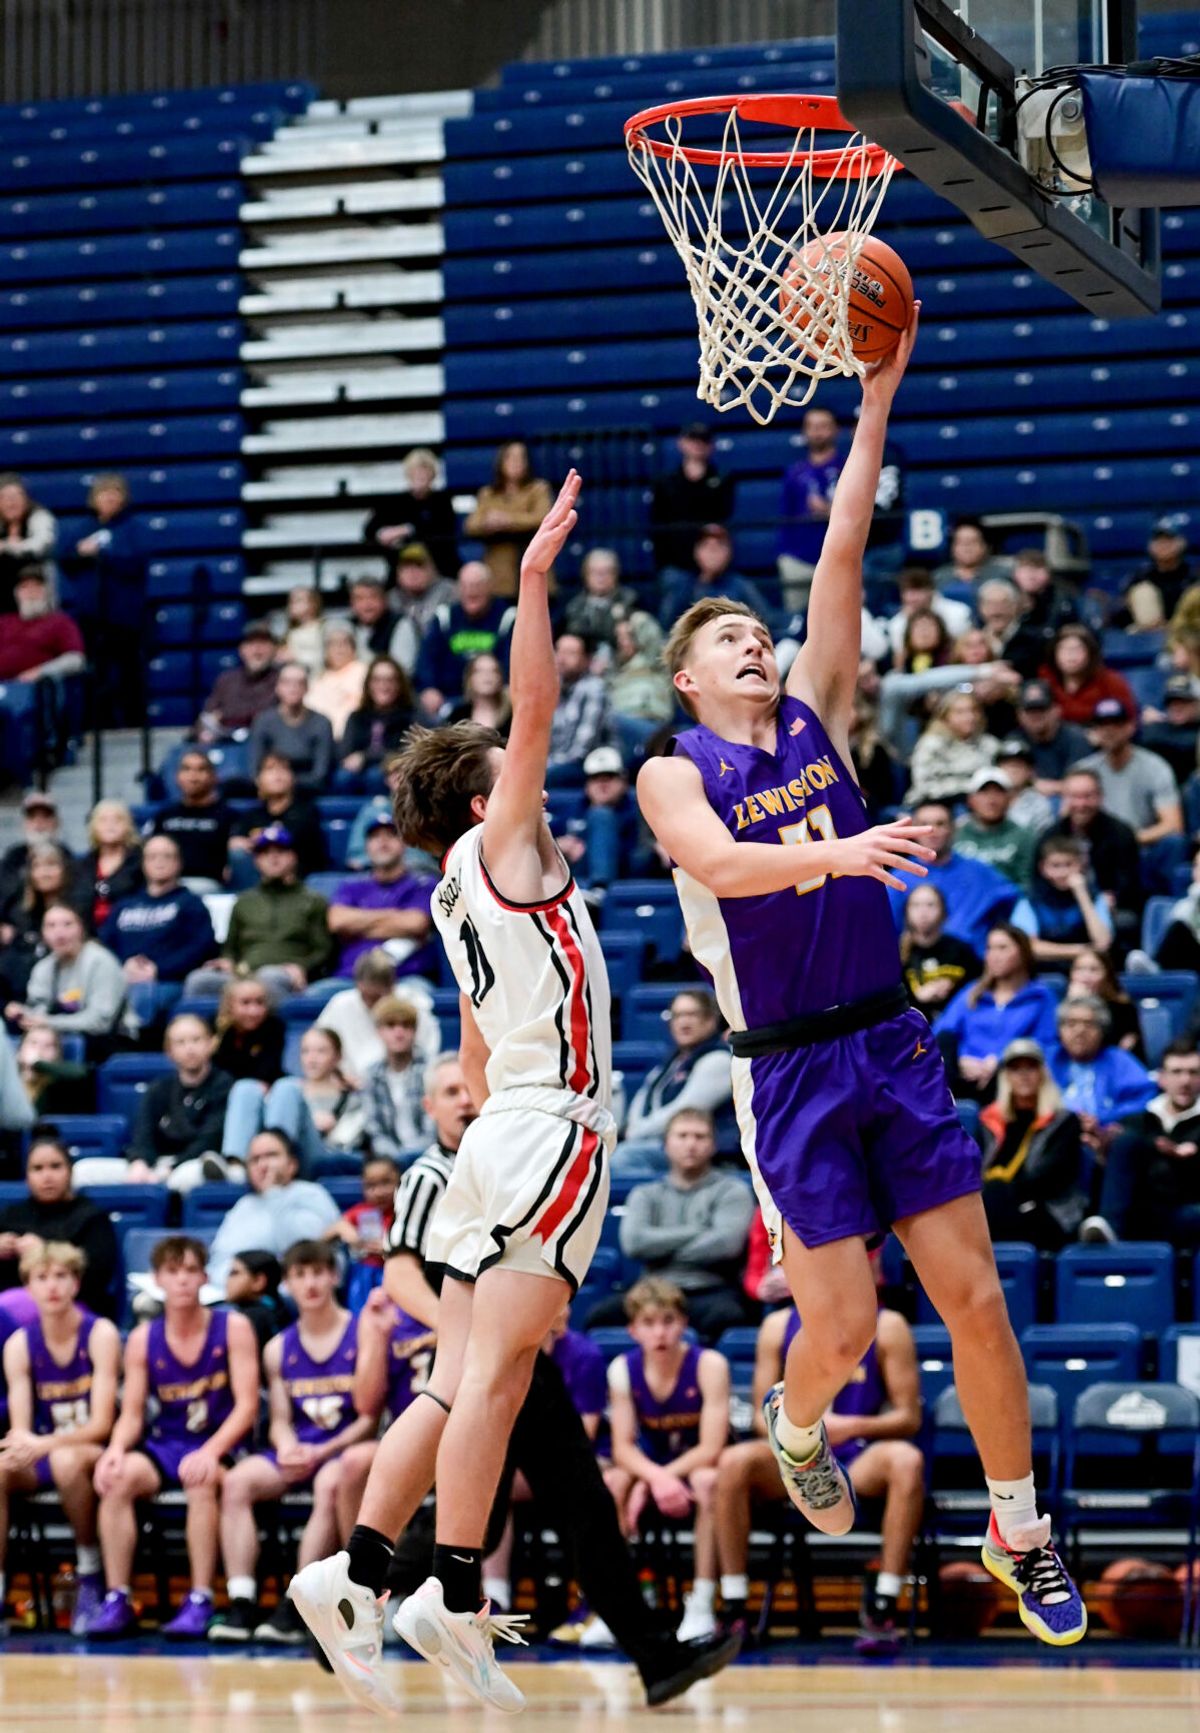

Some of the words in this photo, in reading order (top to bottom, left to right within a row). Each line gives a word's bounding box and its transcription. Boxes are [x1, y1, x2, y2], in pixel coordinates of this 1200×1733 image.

[909, 509, 943, 551] B
[733, 755, 839, 830] LEWISTON
[301, 1395, 344, 1430] 15
